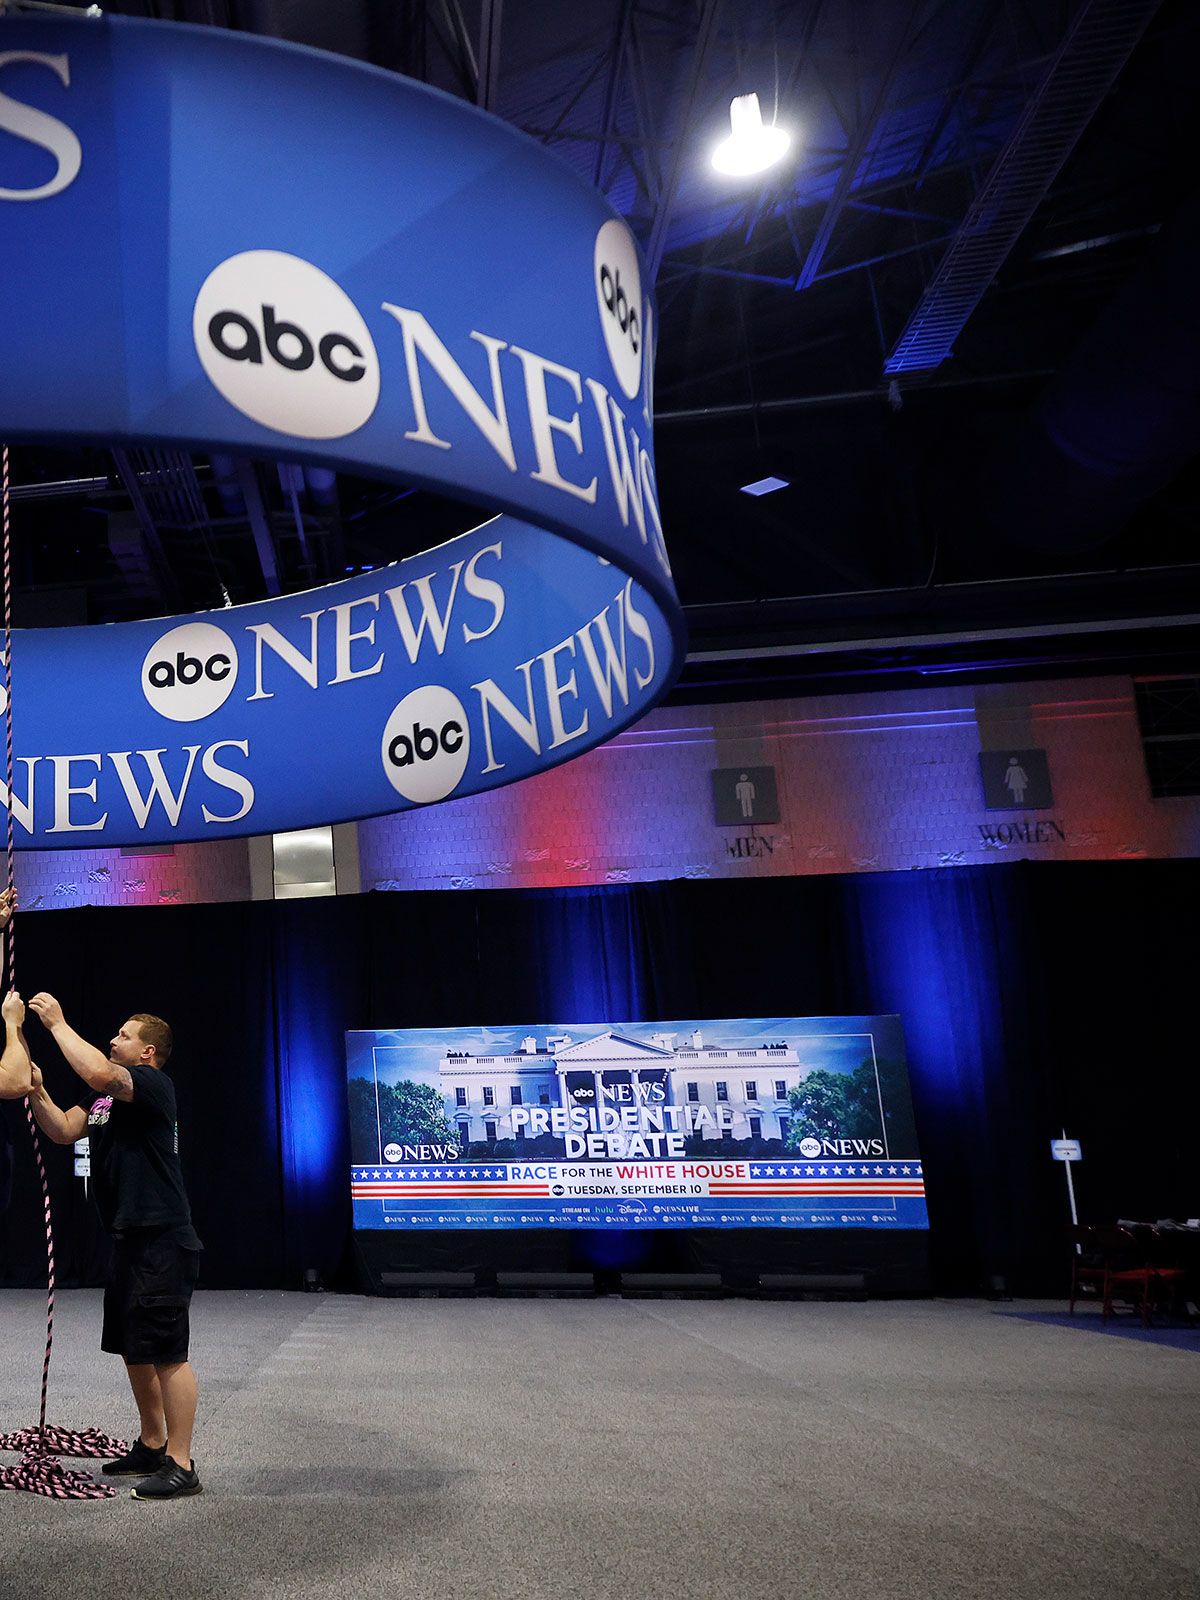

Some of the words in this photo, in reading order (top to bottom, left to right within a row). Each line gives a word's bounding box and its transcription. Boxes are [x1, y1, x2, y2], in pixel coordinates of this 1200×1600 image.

[601, 263, 639, 354] abc
[208, 304, 367, 382] abc
[381, 301, 671, 578] NEWS
[147, 652, 232, 688] abc
[245, 541, 506, 701] NEWS
[388, 720, 464, 767] abc
[470, 577, 656, 775] NEWS
[977, 820, 1067, 845] WOMEN
[573, 1087, 595, 1098] abc
[597, 1082, 666, 1102] NEWS
[511, 1104, 734, 1133] PRESIDENTIAL
[403, 1144, 459, 1160] NEWS
[564, 1132, 686, 1159] DEBATE
[821, 1139, 884, 1156] NEWS
[512, 1165, 558, 1180] RACE
[562, 1168, 587, 1179] FOR
[589, 1168, 613, 1178] THE
[616, 1165, 676, 1179] WHITE
[682, 1164, 746, 1179] HOUSE
[567, 1185, 619, 1196] TUESDAY,
[621, 1184, 687, 1195] SEPTEMBER
[689, 1184, 702, 1194] 10
[595, 1205, 614, 1213] hulu
